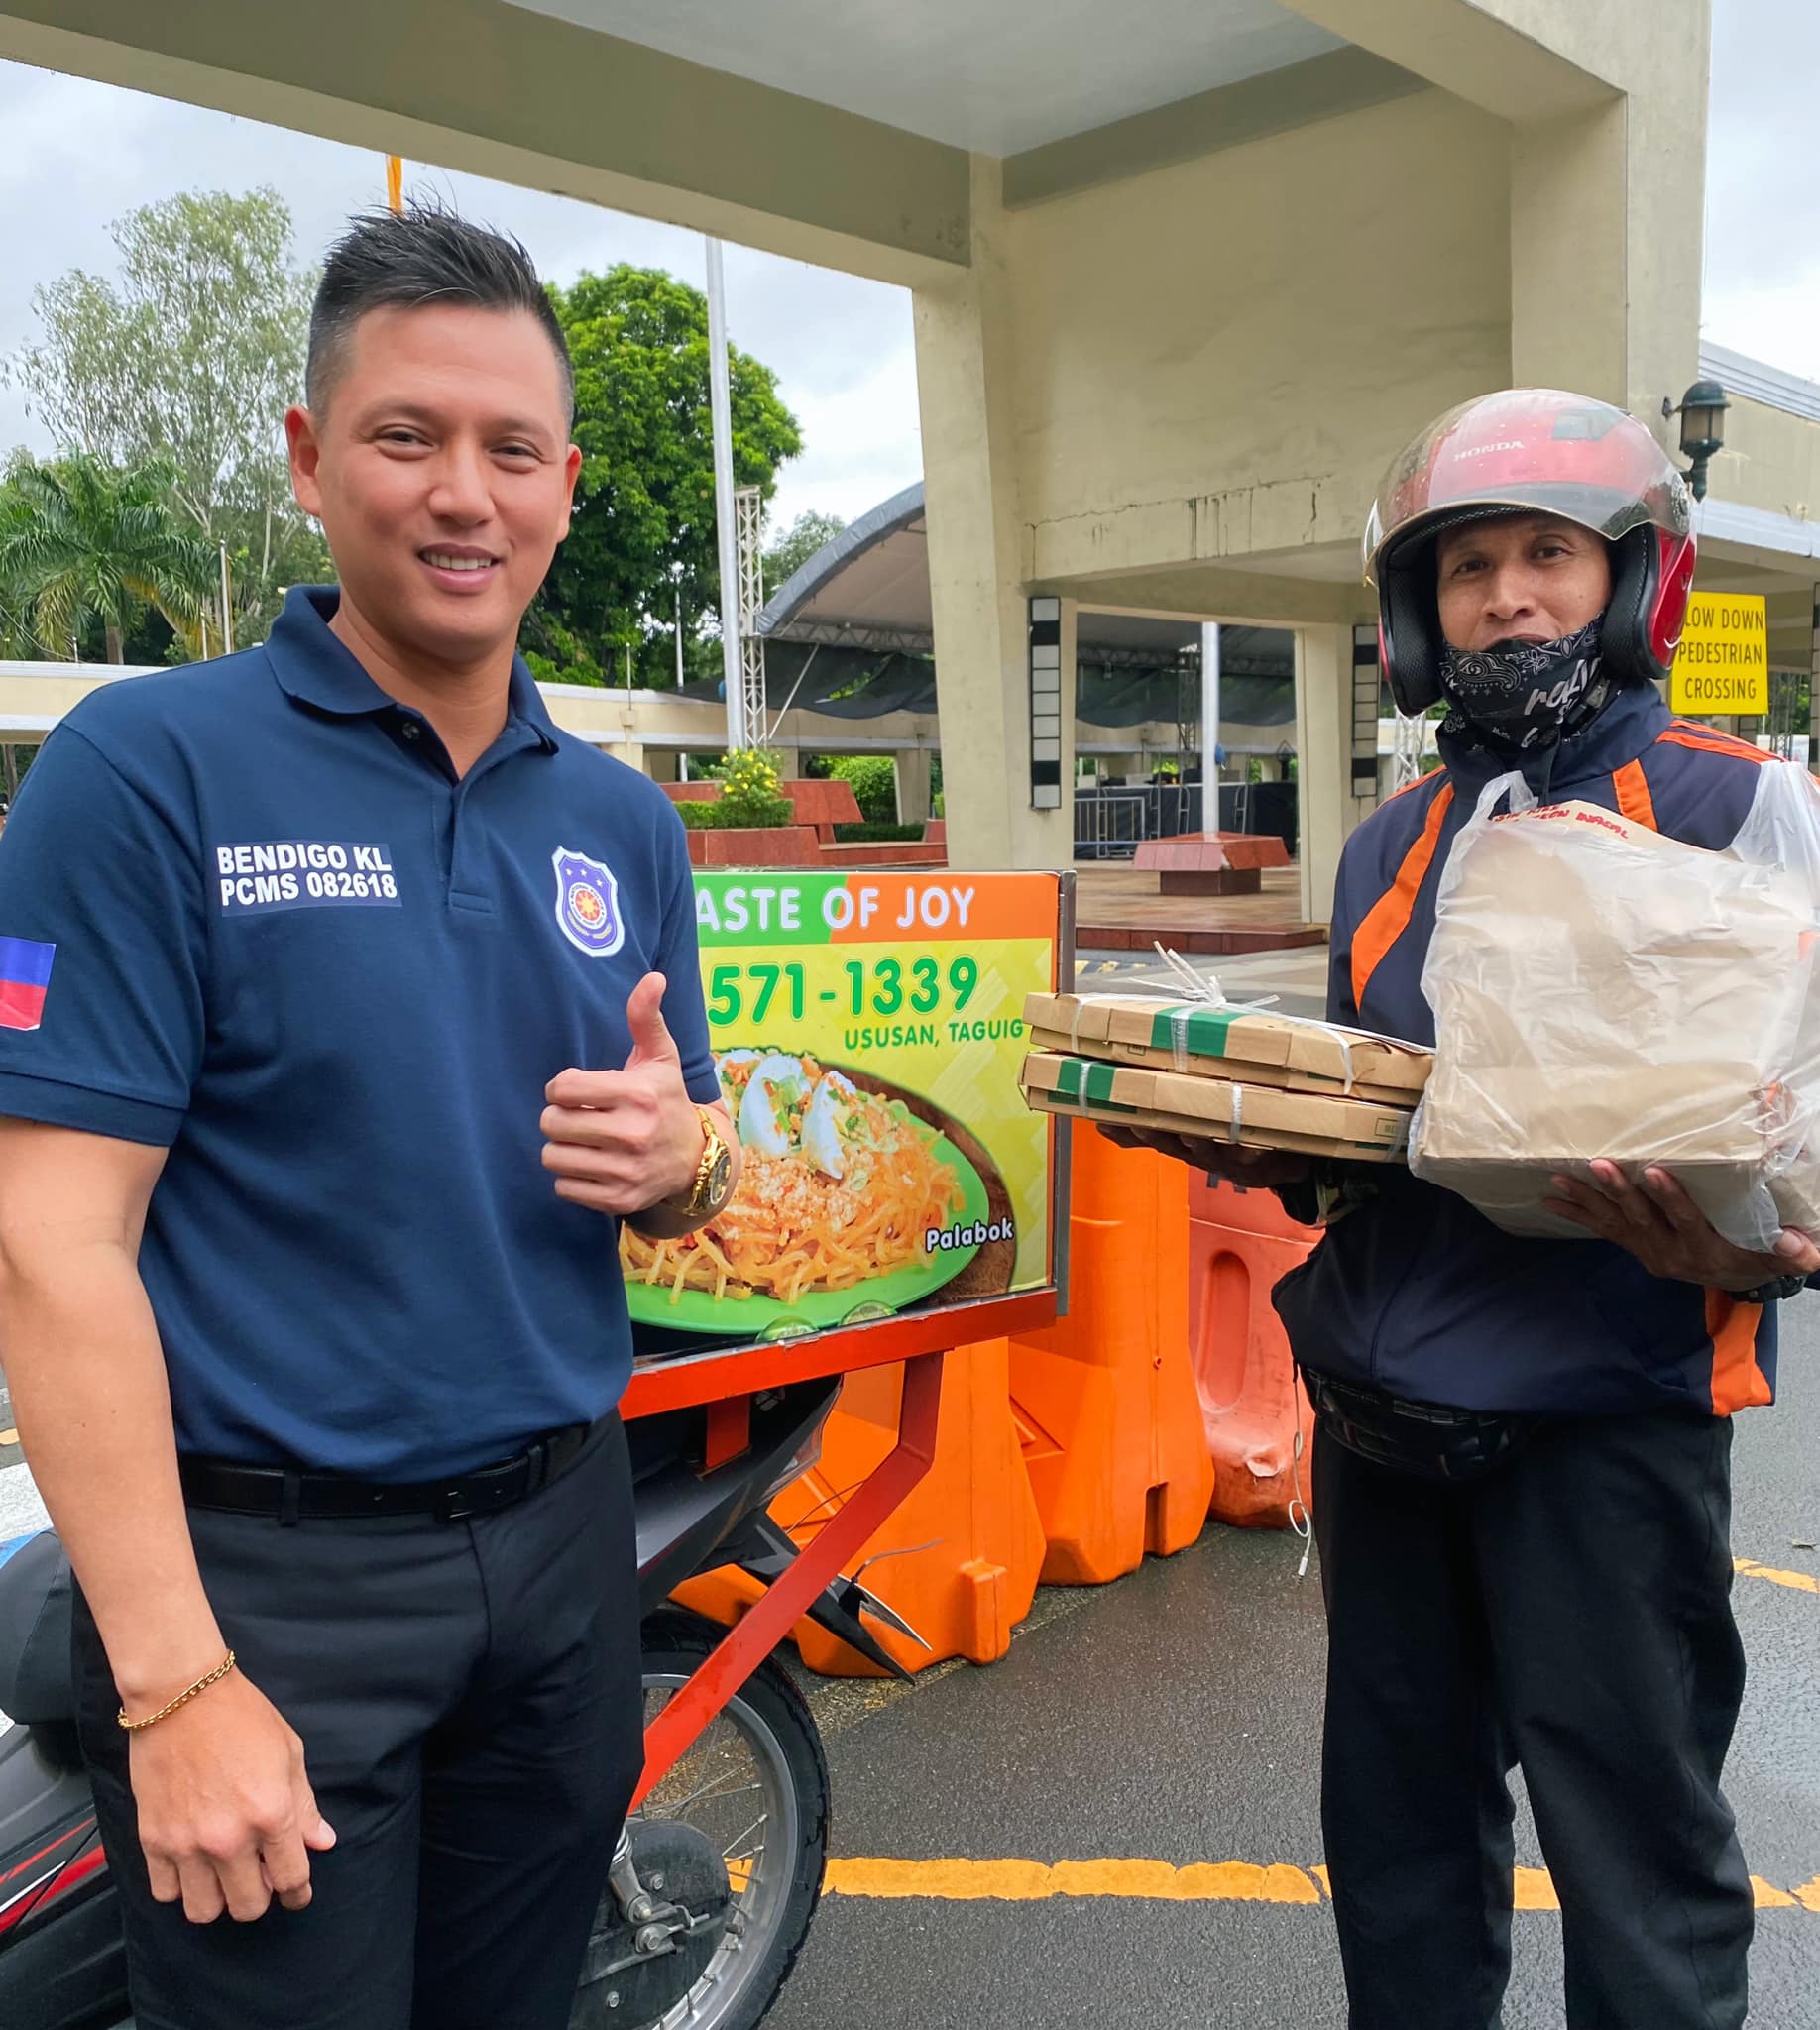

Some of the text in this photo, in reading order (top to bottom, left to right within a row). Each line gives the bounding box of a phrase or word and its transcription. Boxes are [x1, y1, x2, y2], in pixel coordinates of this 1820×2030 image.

[1453, 440, 1525, 462] HONDA
[1684, 607, 1763, 630] LOW DOWN
[1679, 641, 1762, 664] PEDESTRIAN
[1685, 677, 1756, 699] CROSSING
[217, 844, 393, 874] BENDIGO KL
[220, 871, 398, 906] PCMS 082618
[696, 885, 975, 932] ASTE OF JOY
[844, 1018, 1024, 1051] USUSAN, TAGUIG
[926, 1216, 1014, 1253] Palabok
